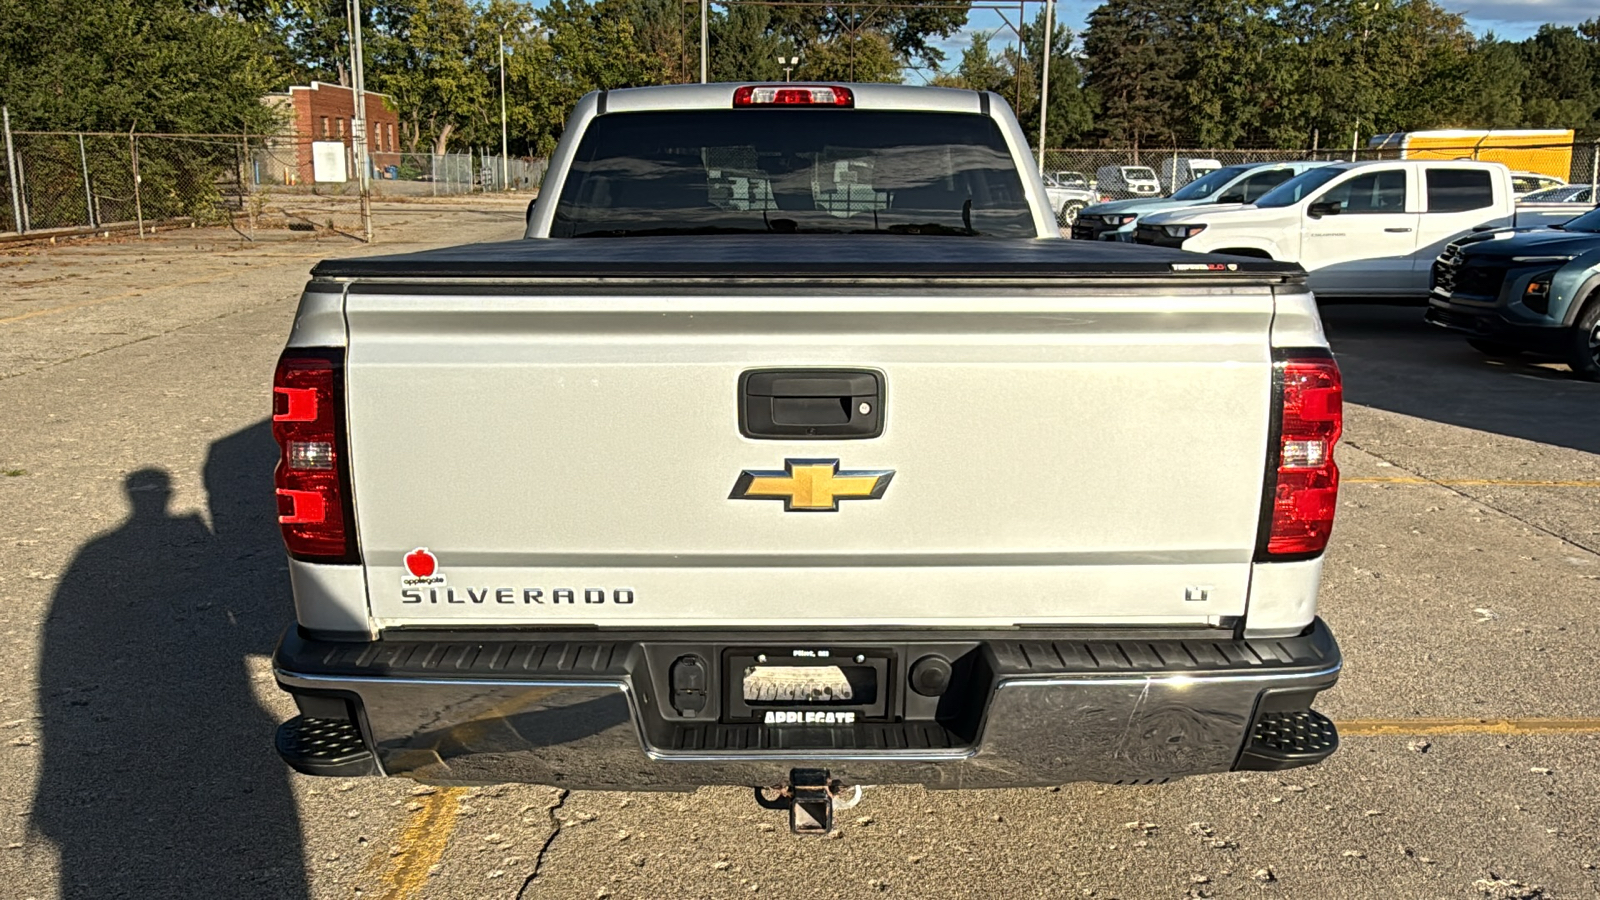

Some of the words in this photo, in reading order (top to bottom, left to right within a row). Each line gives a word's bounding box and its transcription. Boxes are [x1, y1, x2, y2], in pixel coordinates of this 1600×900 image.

[403, 577, 444, 585] applegate
[402, 587, 635, 604] SILVERADO
[764, 711, 855, 723] APPLEGATE
